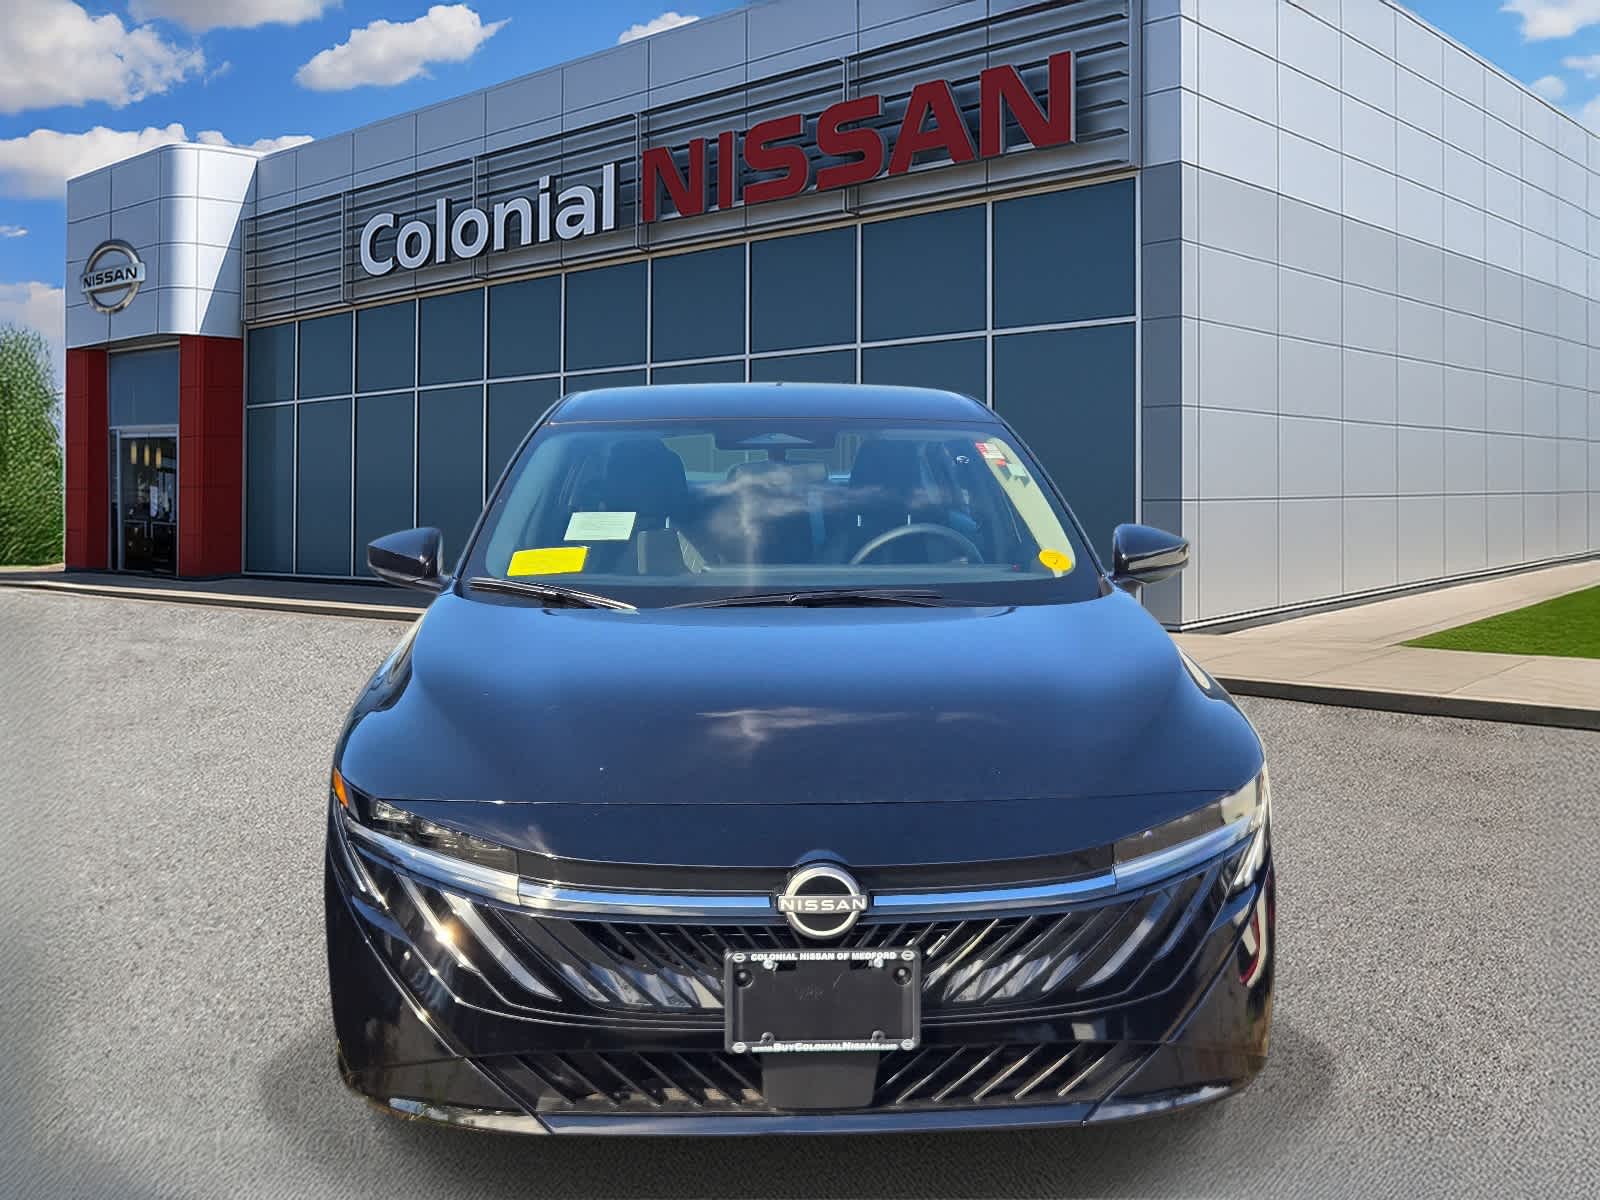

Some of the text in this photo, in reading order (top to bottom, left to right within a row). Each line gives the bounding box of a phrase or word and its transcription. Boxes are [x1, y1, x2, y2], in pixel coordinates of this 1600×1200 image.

[360, 50, 1076, 277] Colonial NISSAN
[83, 266, 138, 289] NISSAN
[781, 898, 865, 911] NISSAN
[750, 951, 897, 961] COLONIAL NISSAN OF MEDFORD
